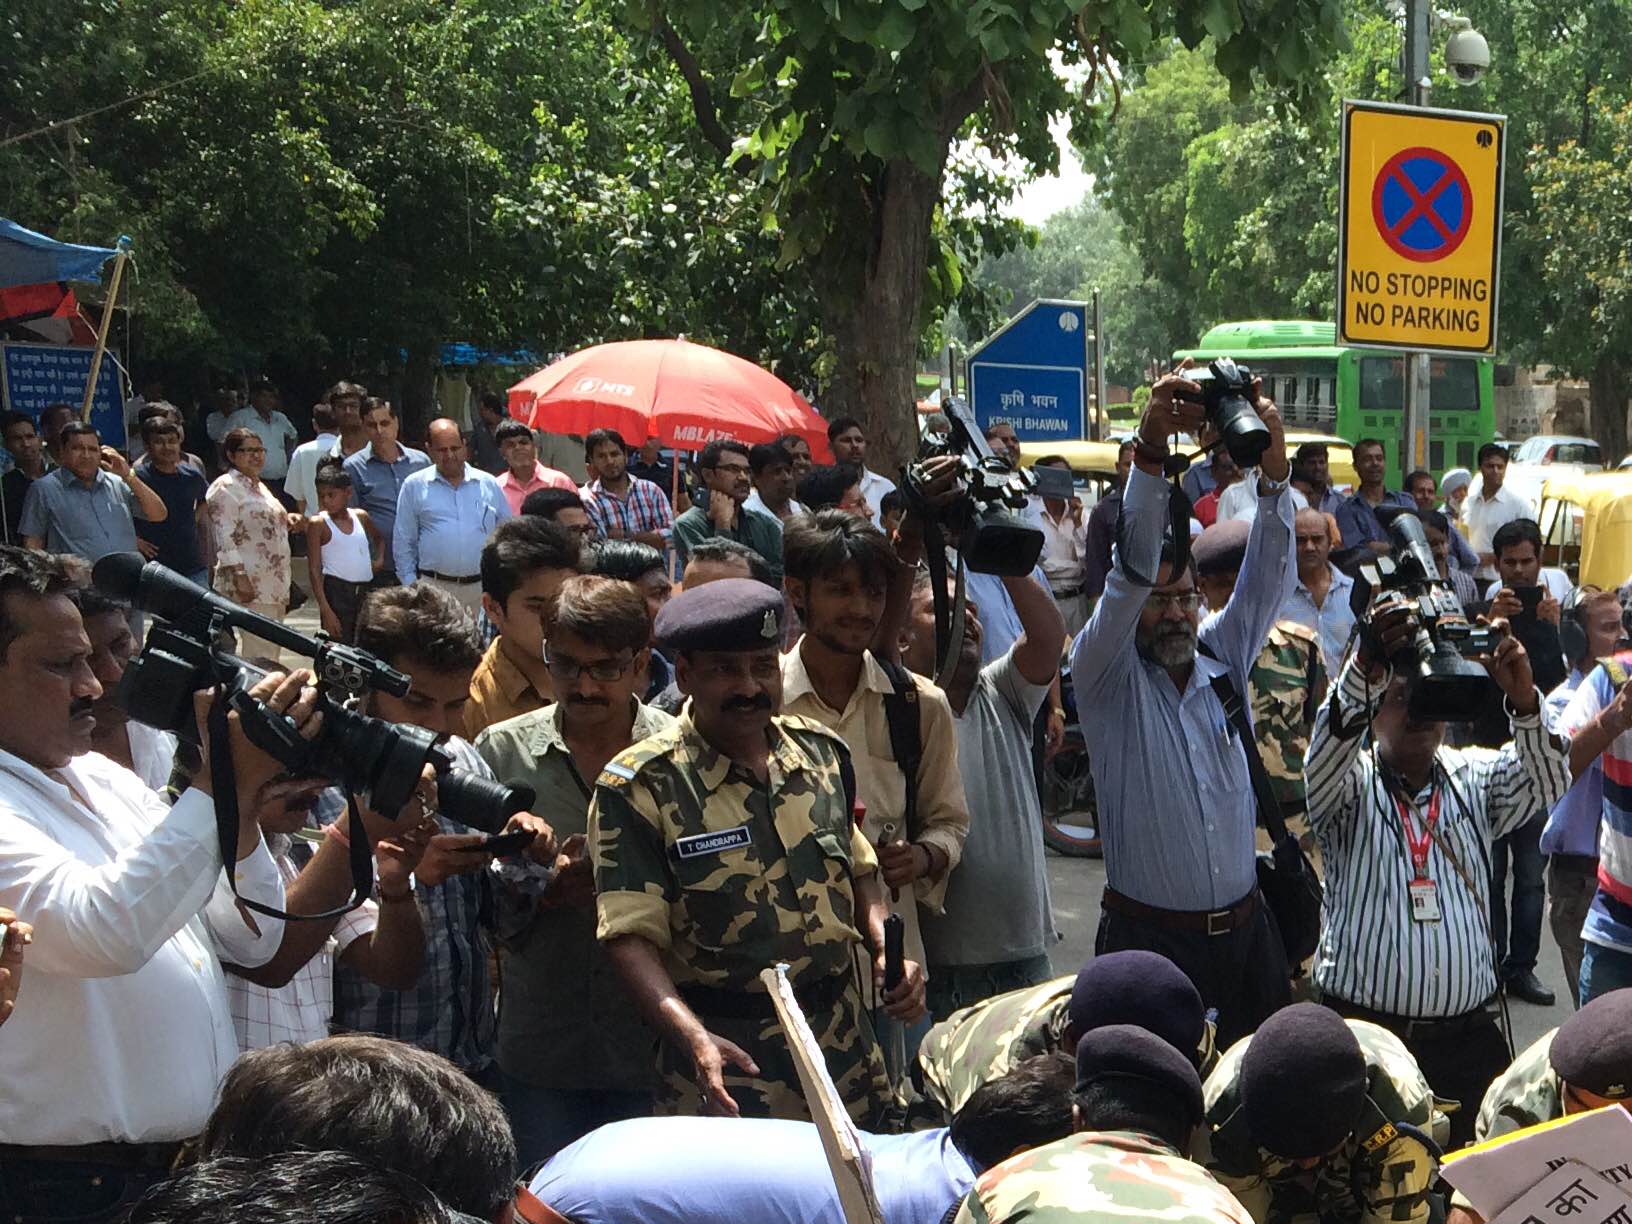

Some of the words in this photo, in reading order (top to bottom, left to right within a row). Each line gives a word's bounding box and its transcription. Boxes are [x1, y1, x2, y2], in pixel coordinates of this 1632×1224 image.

[1351, 270, 1379, 294] NO
[1386, 272, 1487, 301] STOPPING
[1356, 302, 1384, 325] NO
[1392, 304, 1479, 332] PARKING
[601, 382, 633, 397] MTS
[1000, 390, 1024, 410] कृषि
[1031, 394, 1058, 408] भवन
[1025, 418, 1068, 431] BHAWAN
[695, 834, 742, 850] CHANDRAPPA
[1545, 1178, 1599, 1217] का
